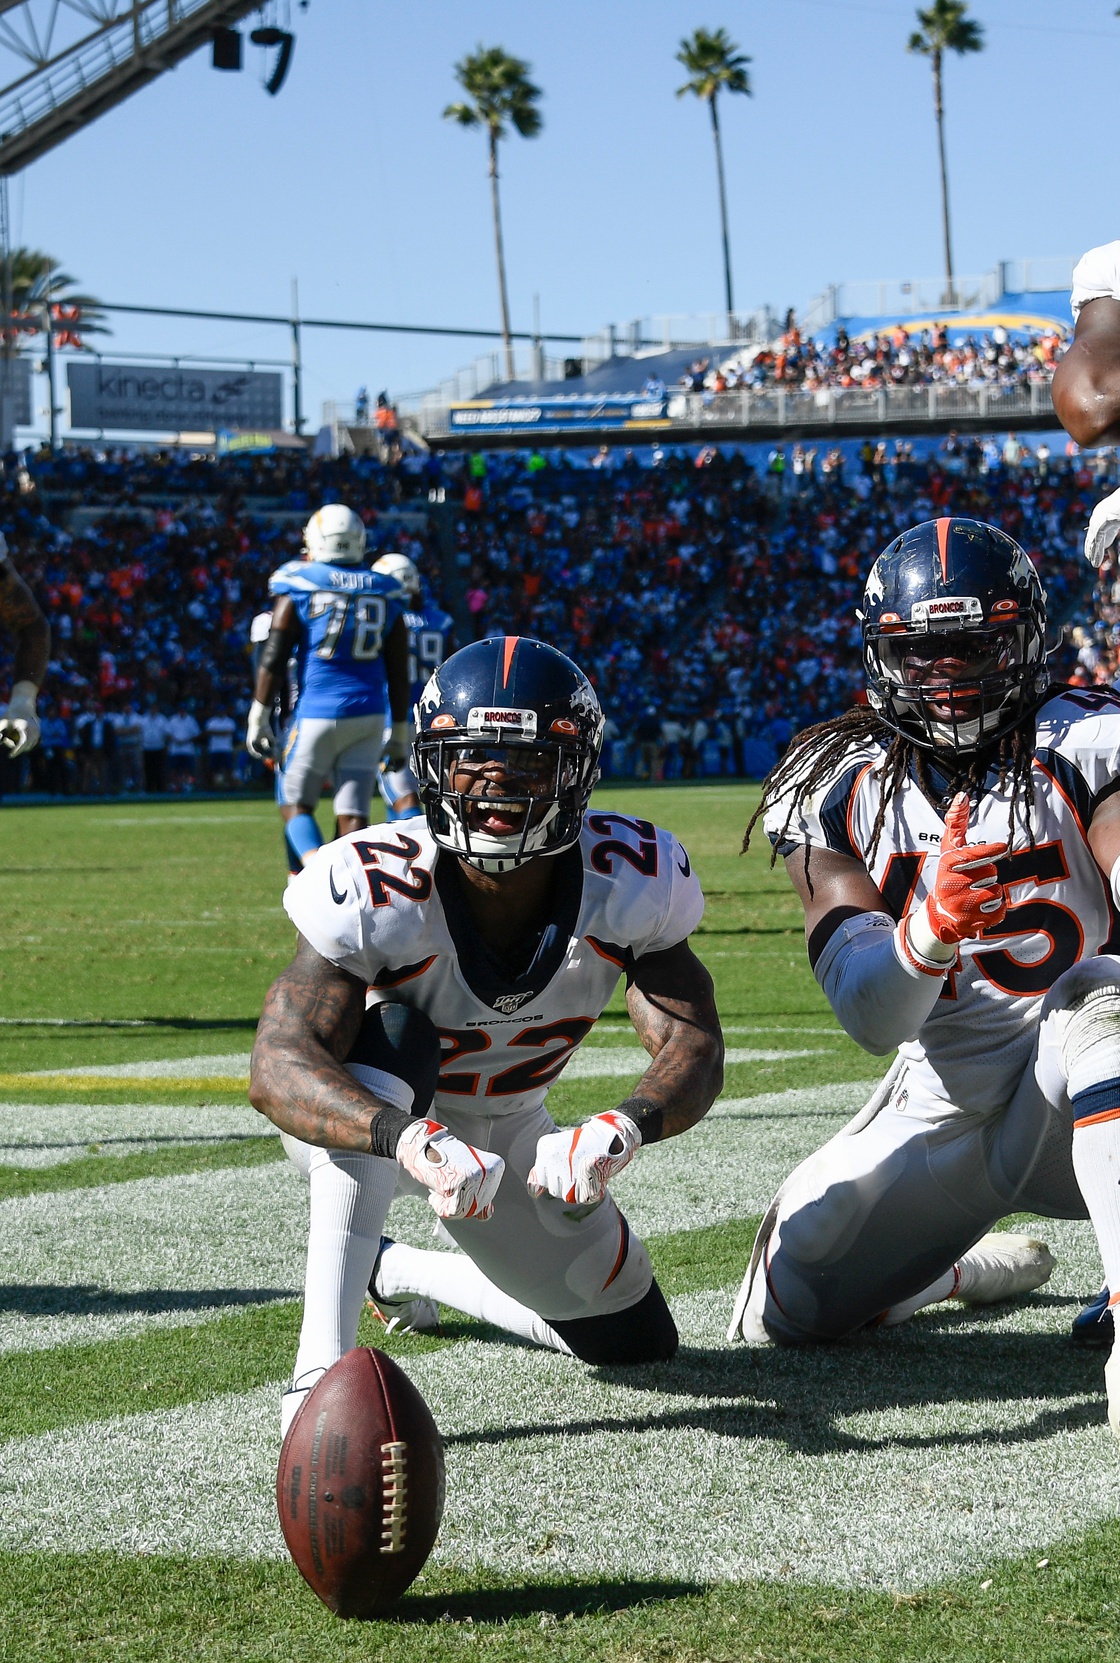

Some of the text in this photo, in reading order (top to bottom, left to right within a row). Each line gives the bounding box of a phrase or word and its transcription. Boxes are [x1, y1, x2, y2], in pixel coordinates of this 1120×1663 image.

[98, 369, 206, 401] kinecta
[329, 570, 376, 590] SCOTT
[929, 601, 965, 614] BRONCOS
[309, 590, 387, 661] 78
[484, 711, 522, 723] BRONCOS
[590, 813, 659, 878] 22
[352, 832, 434, 909] 22
[465, 1014, 544, 1027] BRONCOS
[436, 1015, 598, 1097] 22
